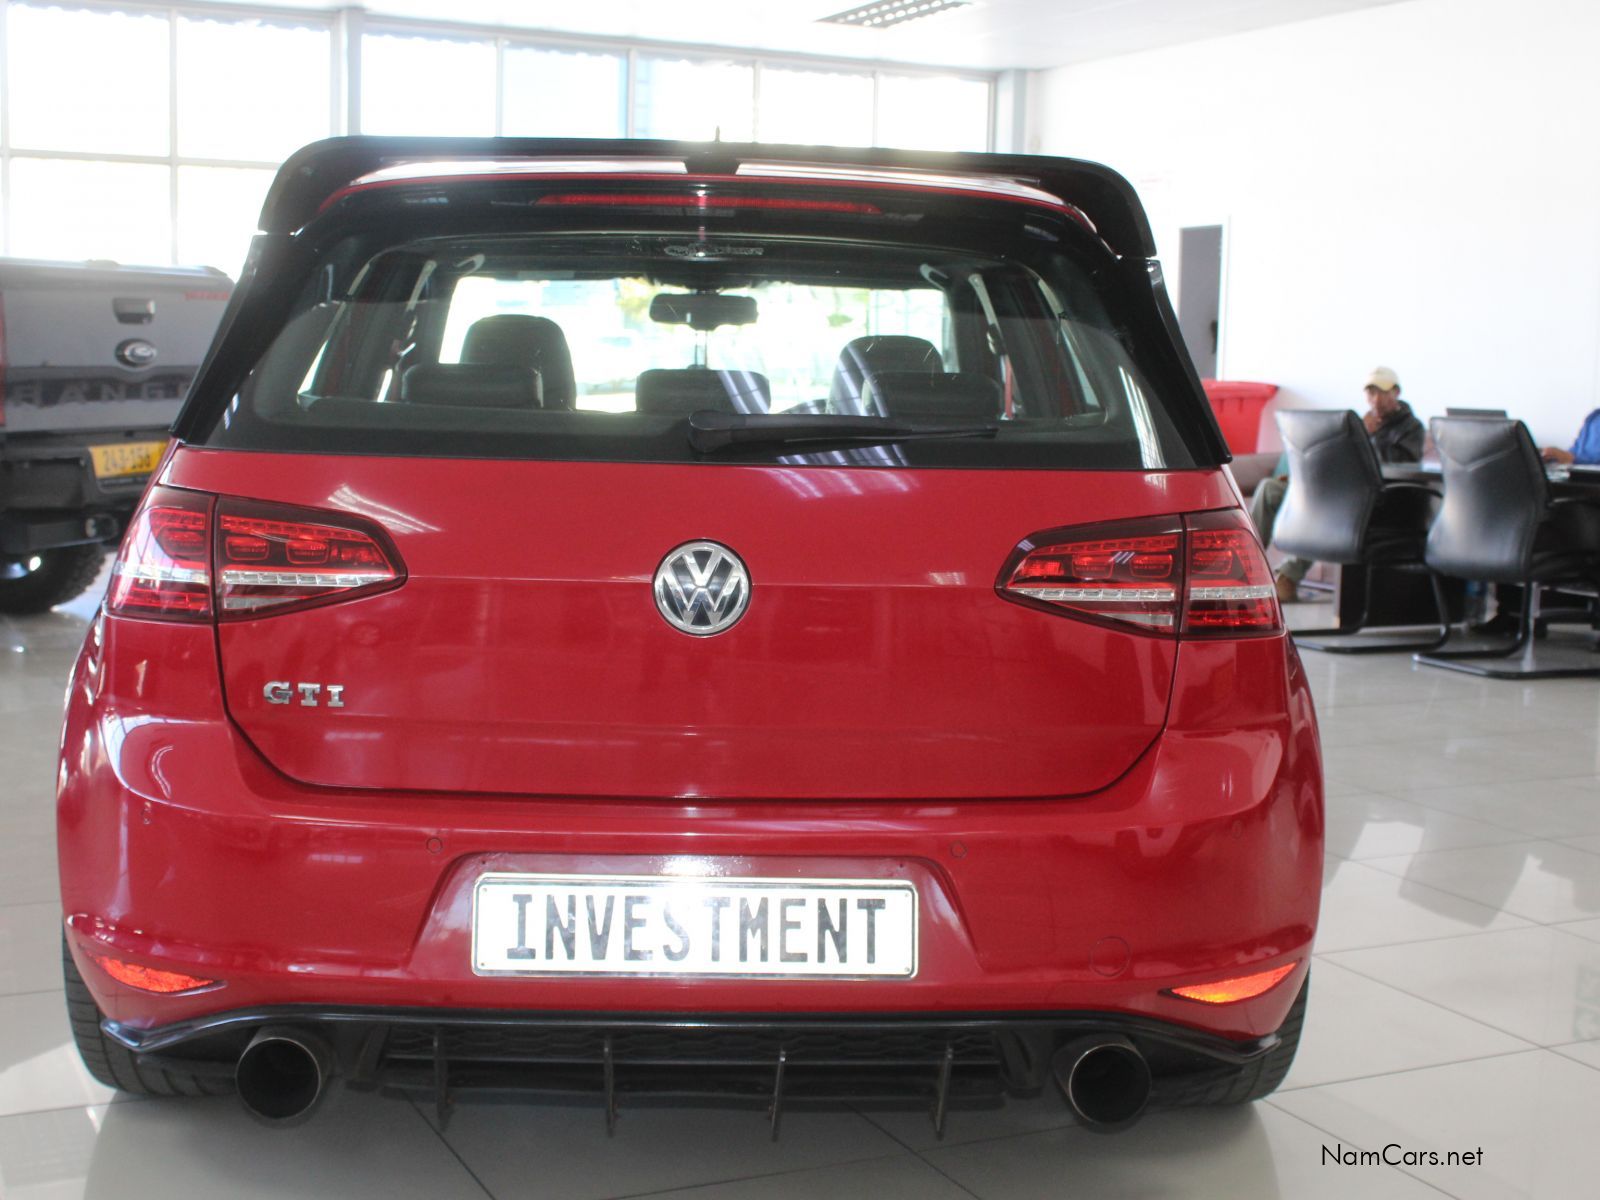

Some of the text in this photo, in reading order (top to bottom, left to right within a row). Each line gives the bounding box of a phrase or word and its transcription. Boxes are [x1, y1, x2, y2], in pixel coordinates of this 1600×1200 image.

[654, 541, 748, 634] VW
[263, 681, 345, 708] GTI
[506, 893, 887, 964] INVESTMENT
